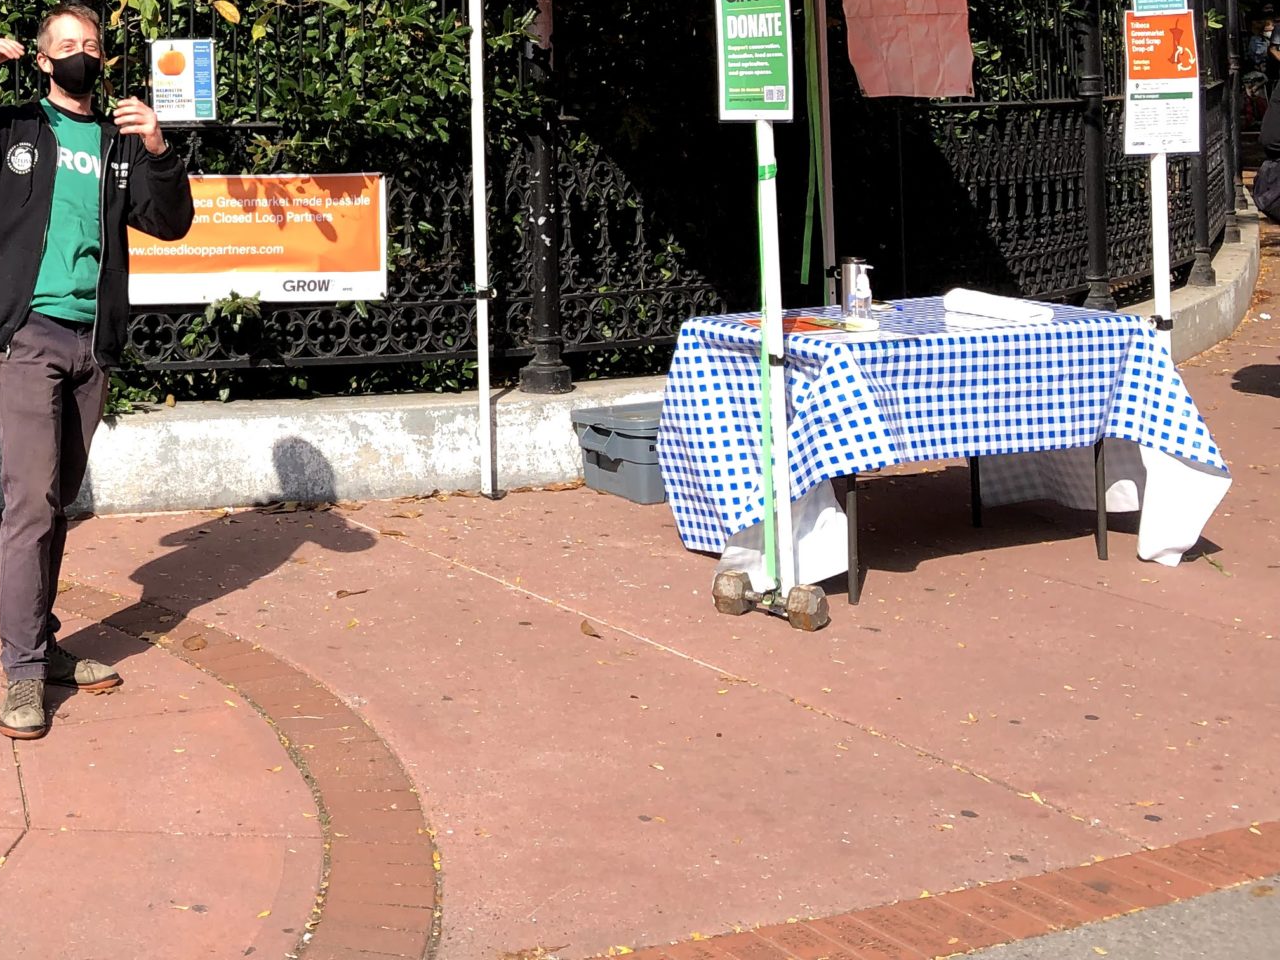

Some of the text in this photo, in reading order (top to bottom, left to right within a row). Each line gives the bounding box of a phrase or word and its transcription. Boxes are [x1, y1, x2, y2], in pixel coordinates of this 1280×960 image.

[726, 12, 783, 39] DONATE
[1131, 29, 1165, 37] Greenmarket
[216, 195, 289, 208] Greenmarket
[292, 195, 322, 207] made
[325, 194, 370, 208] possible
[213, 212, 252, 224] Closed
[255, 211, 283, 228] Loop
[286, 211, 333, 224] Partners
[282, 279, 331, 292] GROW
